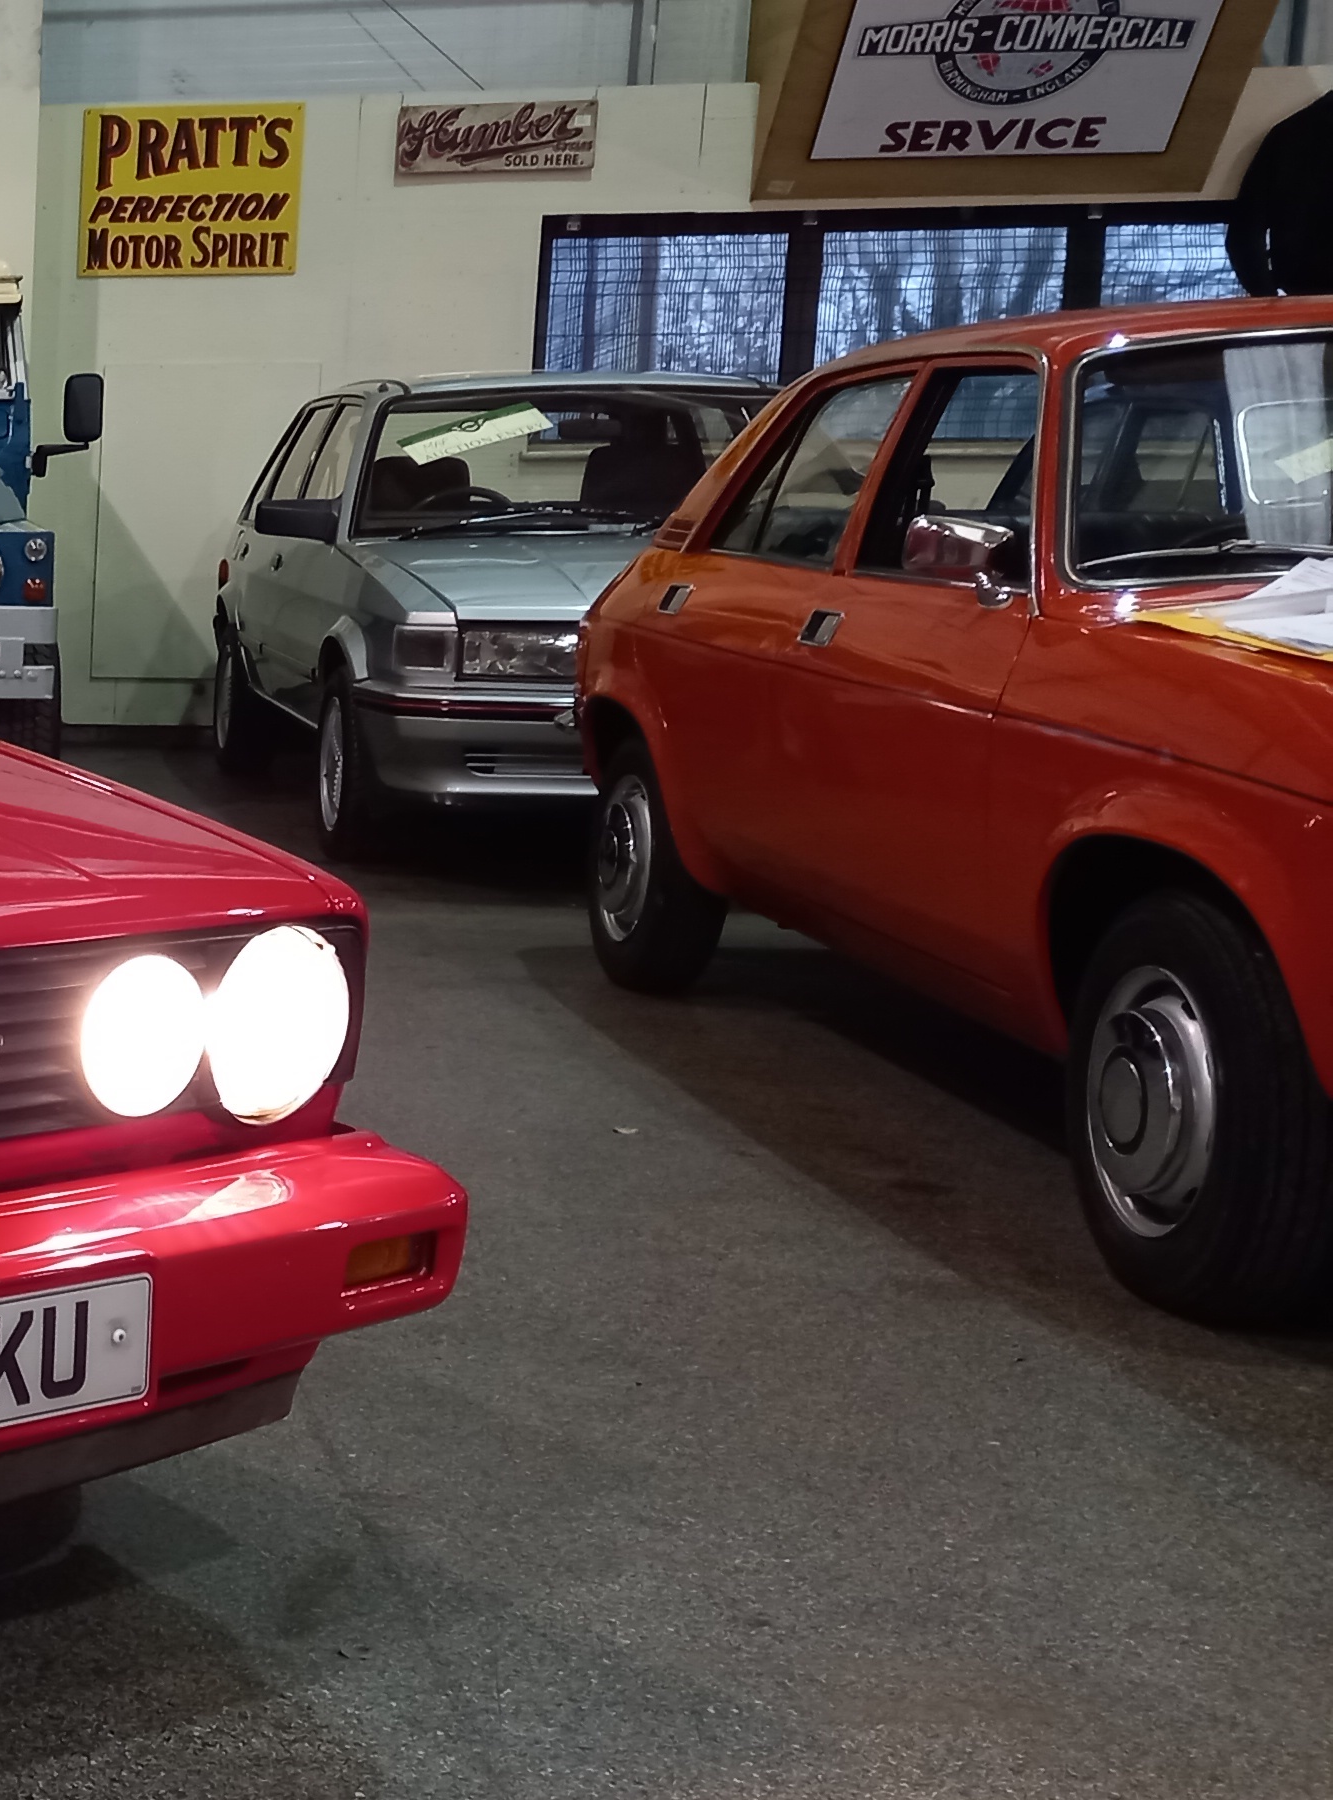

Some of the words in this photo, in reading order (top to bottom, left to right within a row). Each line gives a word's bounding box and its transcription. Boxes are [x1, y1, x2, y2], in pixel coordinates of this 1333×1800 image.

[938, 58, 1009, 104] BIRMINGHAM
[1026, 58, 1091, 100] ENGLAND
[95, 113, 294, 193] PRATT'S
[398, 101, 583, 168] Humber
[878, 116, 1108, 154] SERVICE
[504, 153, 539, 168] SOLD
[543, 152, 584, 167] HERE.
[87, 192, 291, 224] PERFECTION
[85, 227, 183, 271] MOTOR
[190, 225, 290, 269] SPIRIT
